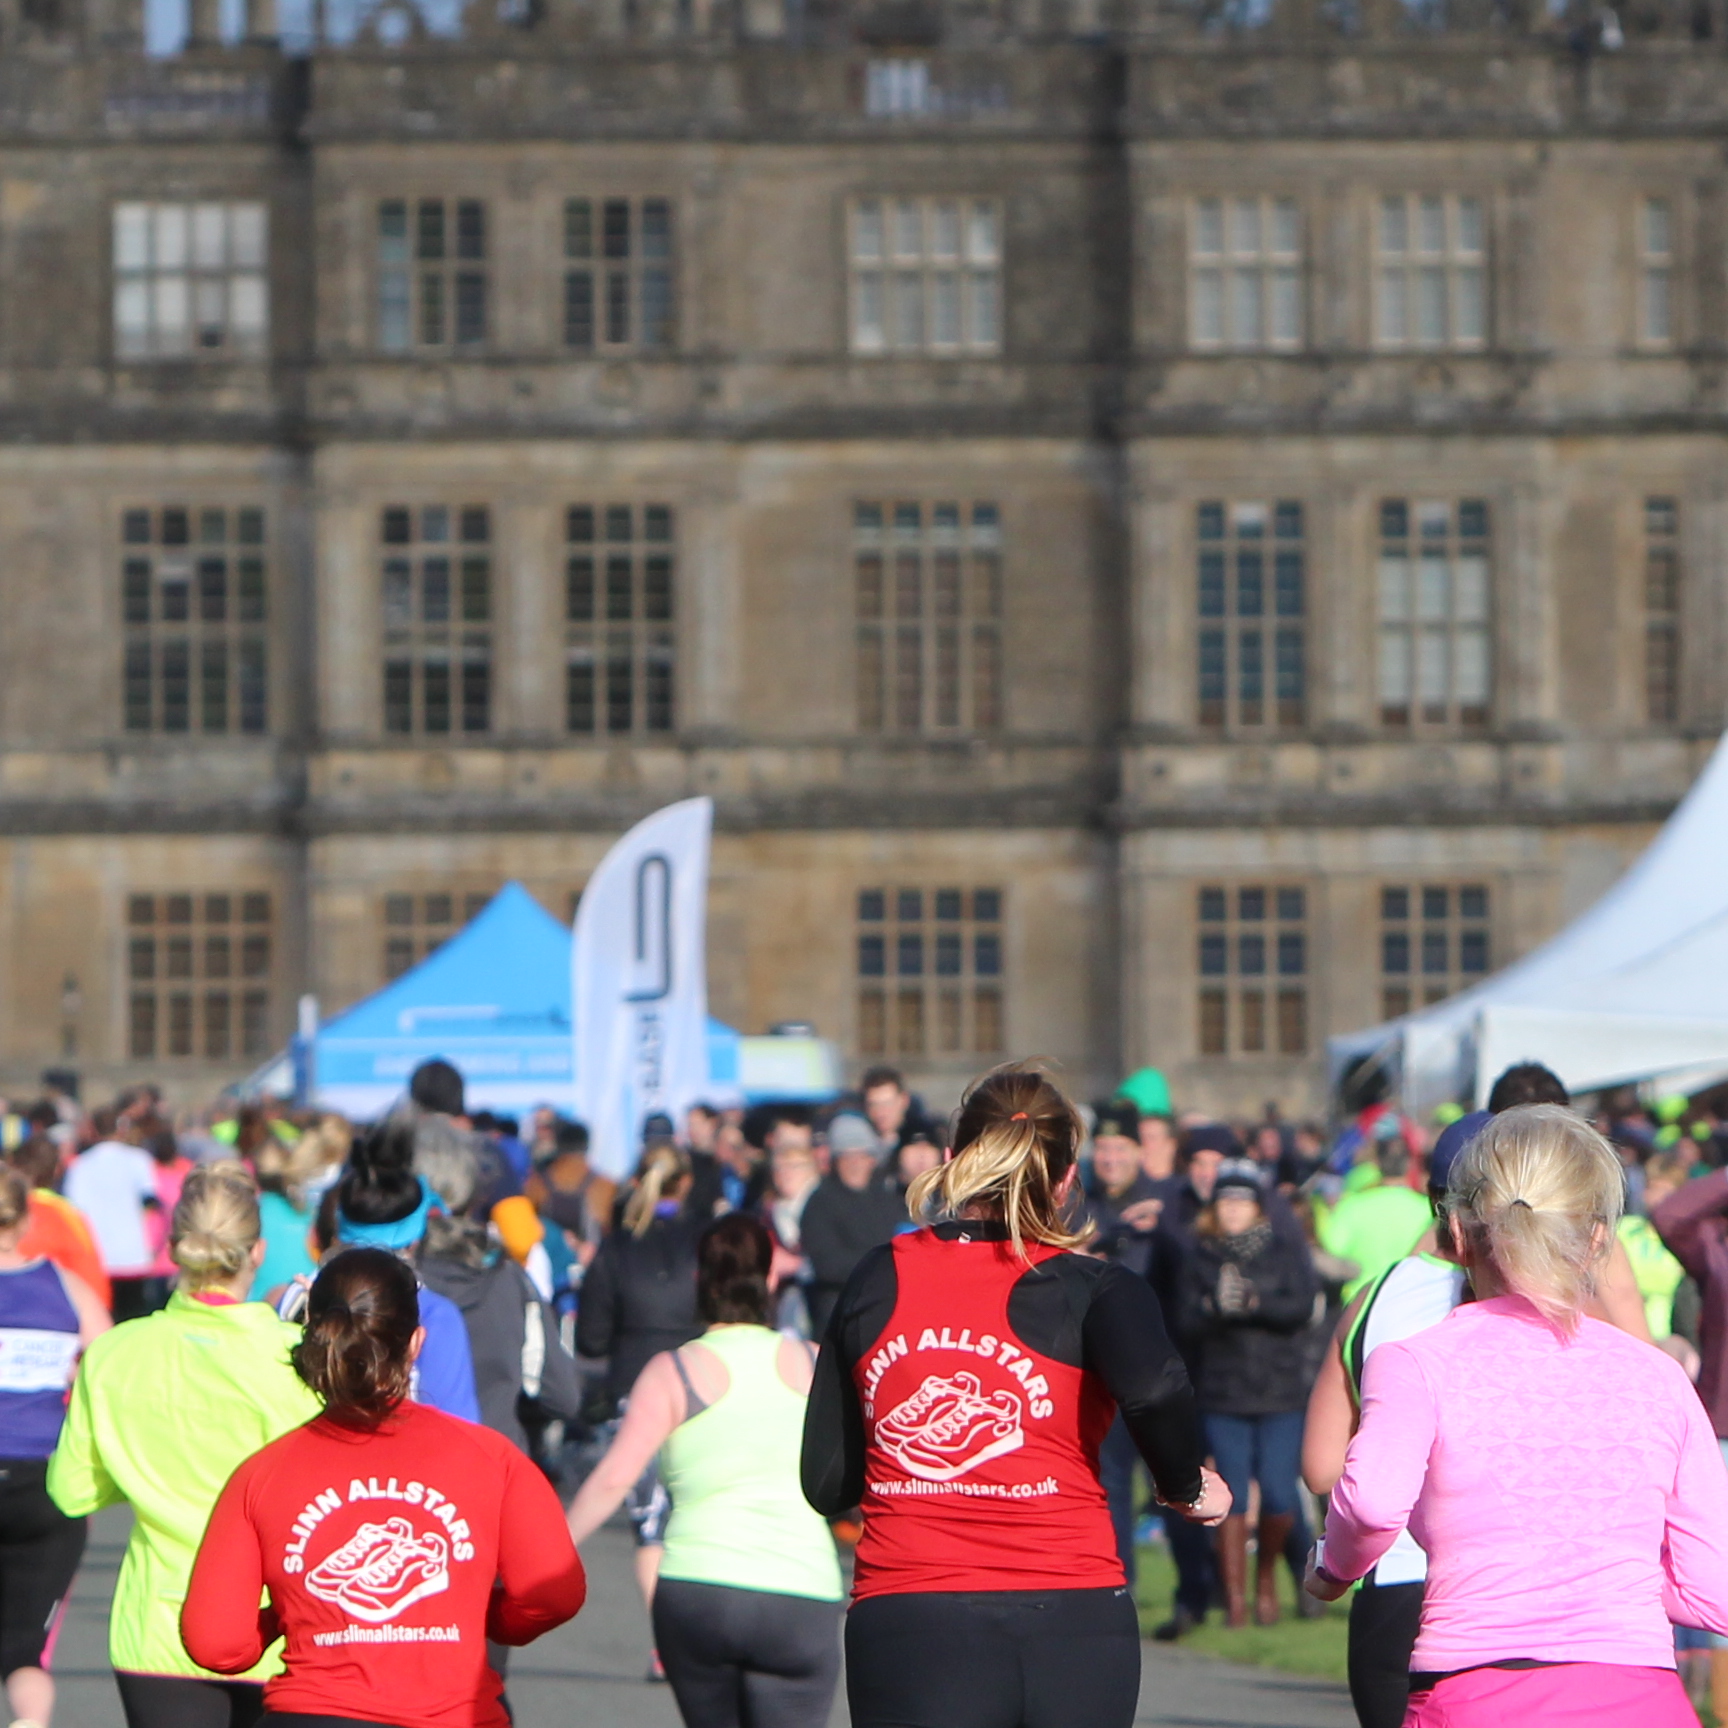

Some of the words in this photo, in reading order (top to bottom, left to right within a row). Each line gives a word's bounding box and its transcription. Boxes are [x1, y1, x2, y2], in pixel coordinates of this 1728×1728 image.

[917, 1327, 1055, 1419] ALLSTARS
[283, 1487, 343, 1574] SLINN
[348, 1477, 475, 1562] ALLSTARS
[313, 1622, 461, 1647] www.slinnallstars.co.uk
